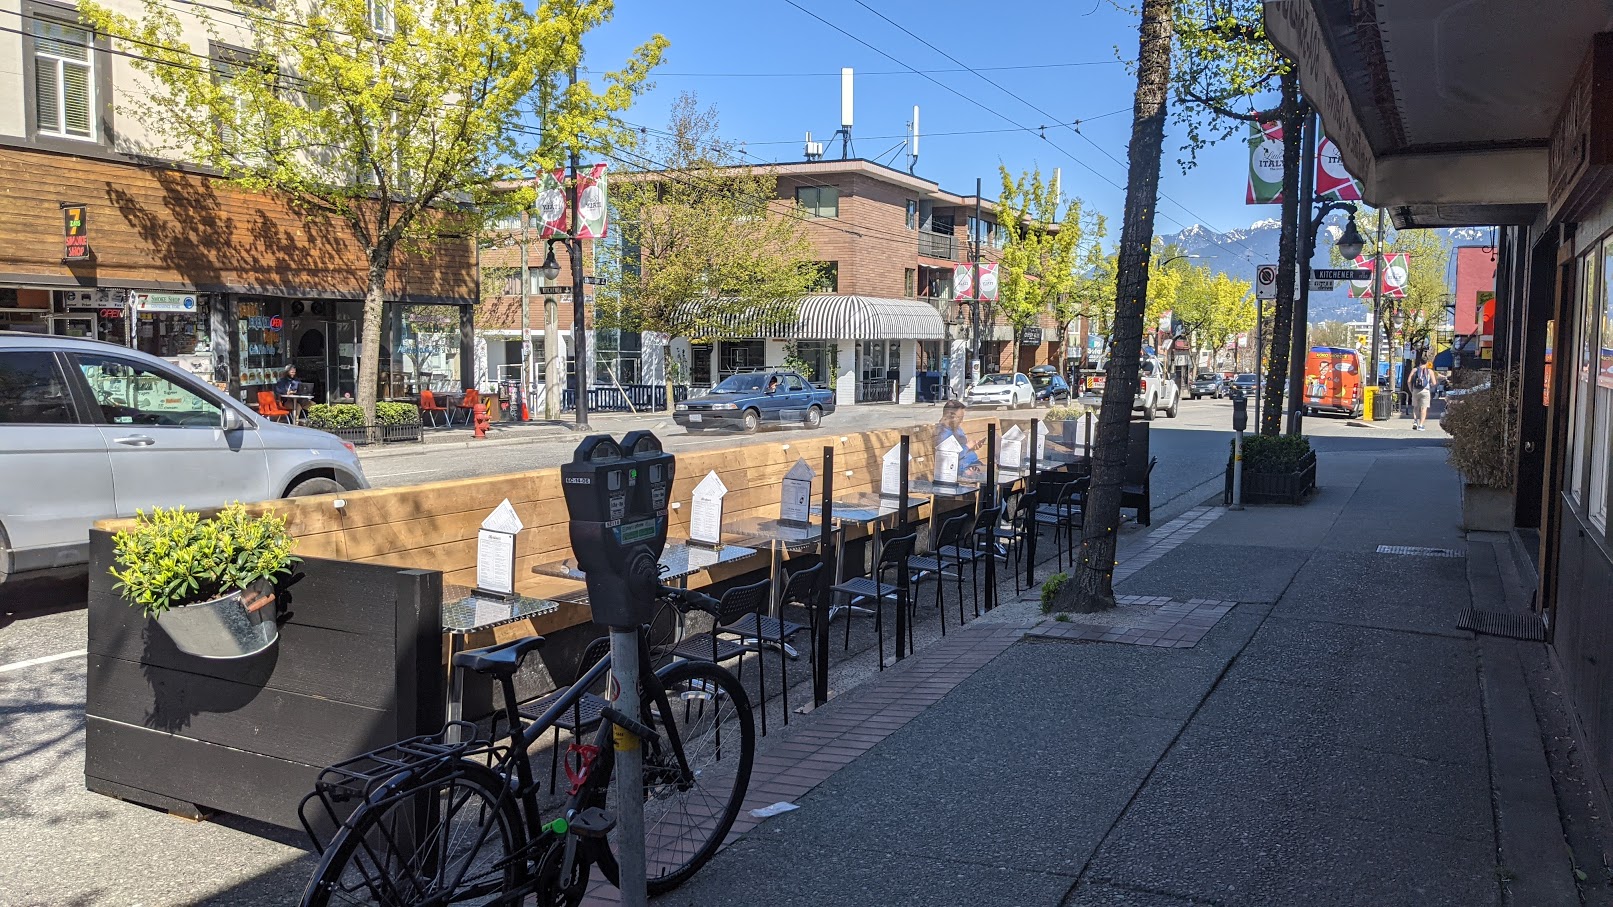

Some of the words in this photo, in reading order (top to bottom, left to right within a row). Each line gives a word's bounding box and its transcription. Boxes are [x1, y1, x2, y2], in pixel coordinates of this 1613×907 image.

[66, 236, 87, 246] SMOKE
[69, 247, 84, 256] SHOP
[1319, 271, 1354, 279] KITCHENER
[100, 309, 125, 318] OPEN
